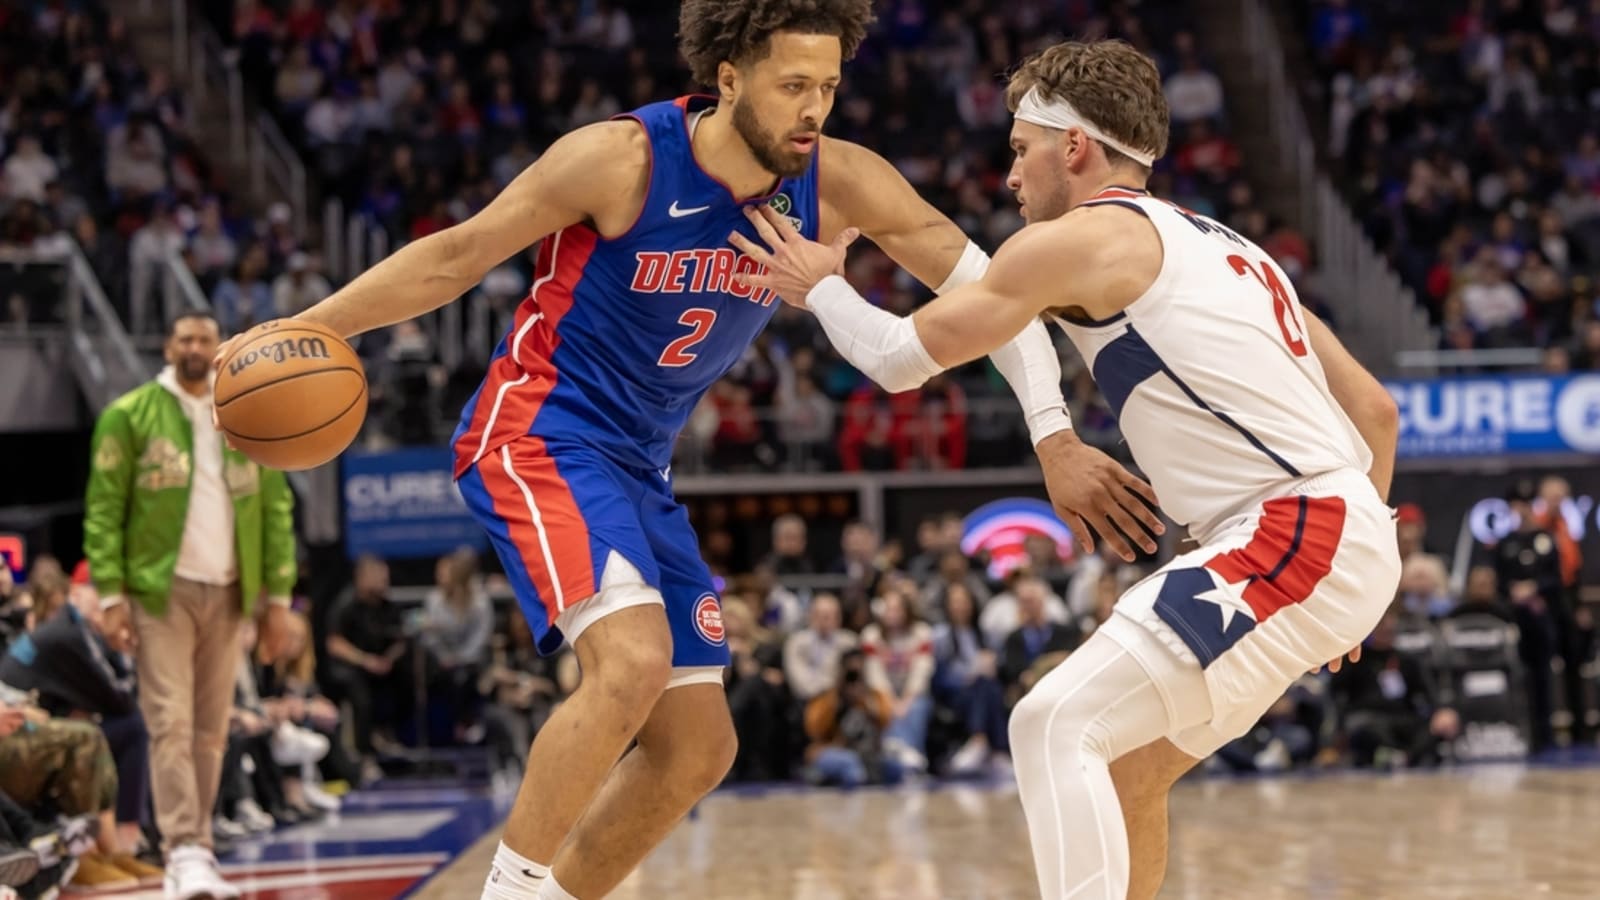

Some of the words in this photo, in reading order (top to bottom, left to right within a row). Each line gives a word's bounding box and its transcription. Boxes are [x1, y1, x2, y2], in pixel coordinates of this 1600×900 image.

[229, 336, 331, 377] Wilson
[657, 308, 717, 367] 2
[346, 471, 447, 506] CURE
